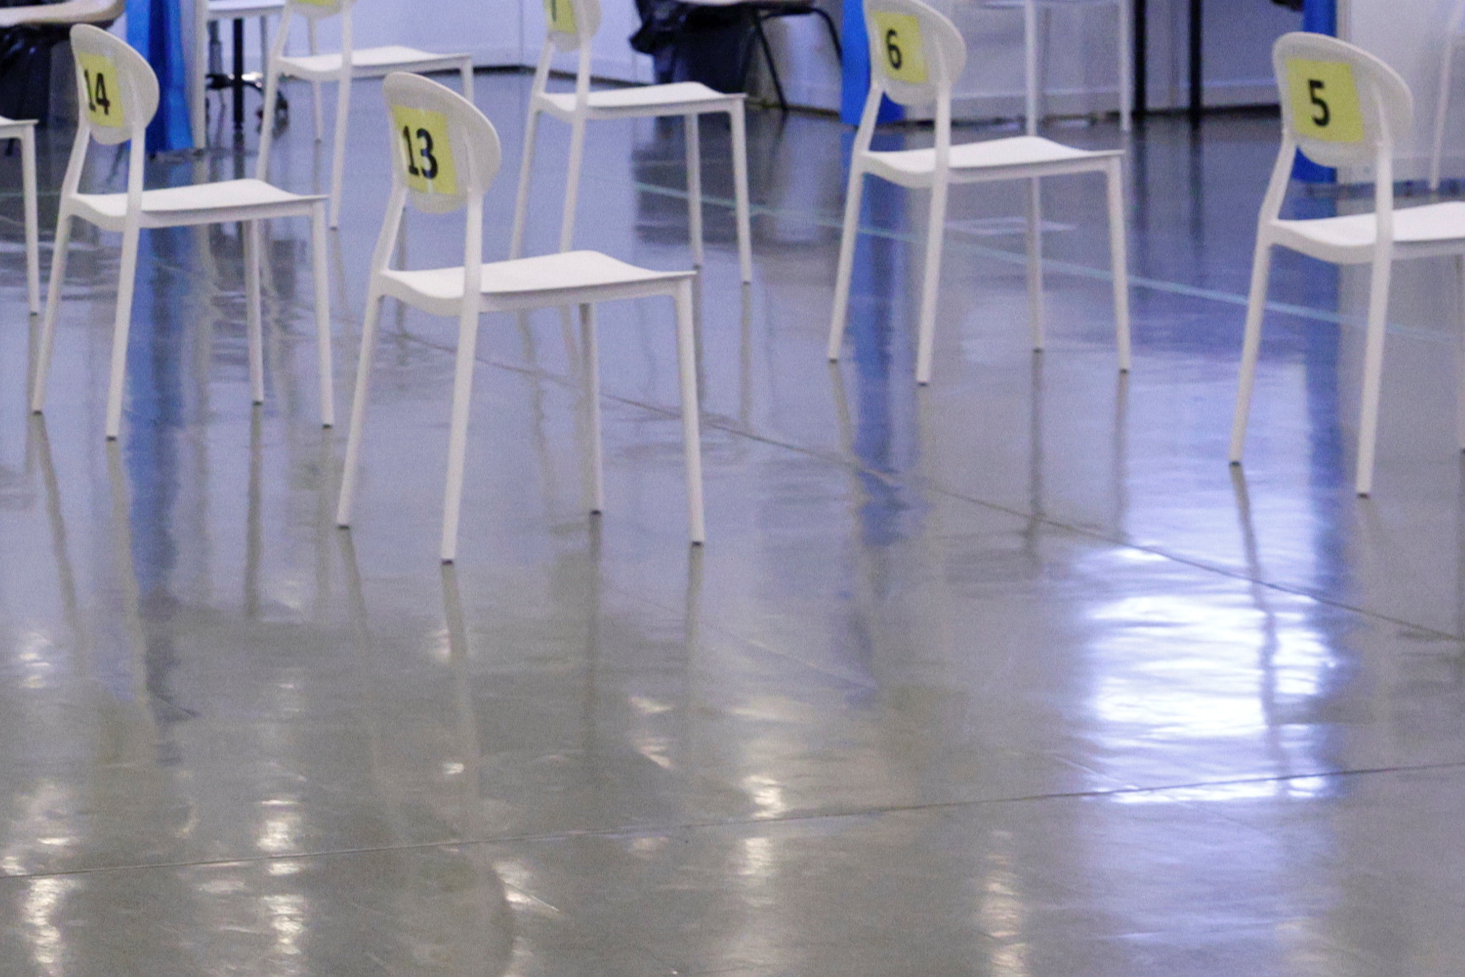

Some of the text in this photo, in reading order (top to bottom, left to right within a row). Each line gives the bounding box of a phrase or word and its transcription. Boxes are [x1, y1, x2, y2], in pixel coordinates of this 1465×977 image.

[885, 28, 903, 70] 6
[83, 68, 111, 116] 14
[1307, 78, 1331, 128] 5
[402, 125, 439, 180] 13
